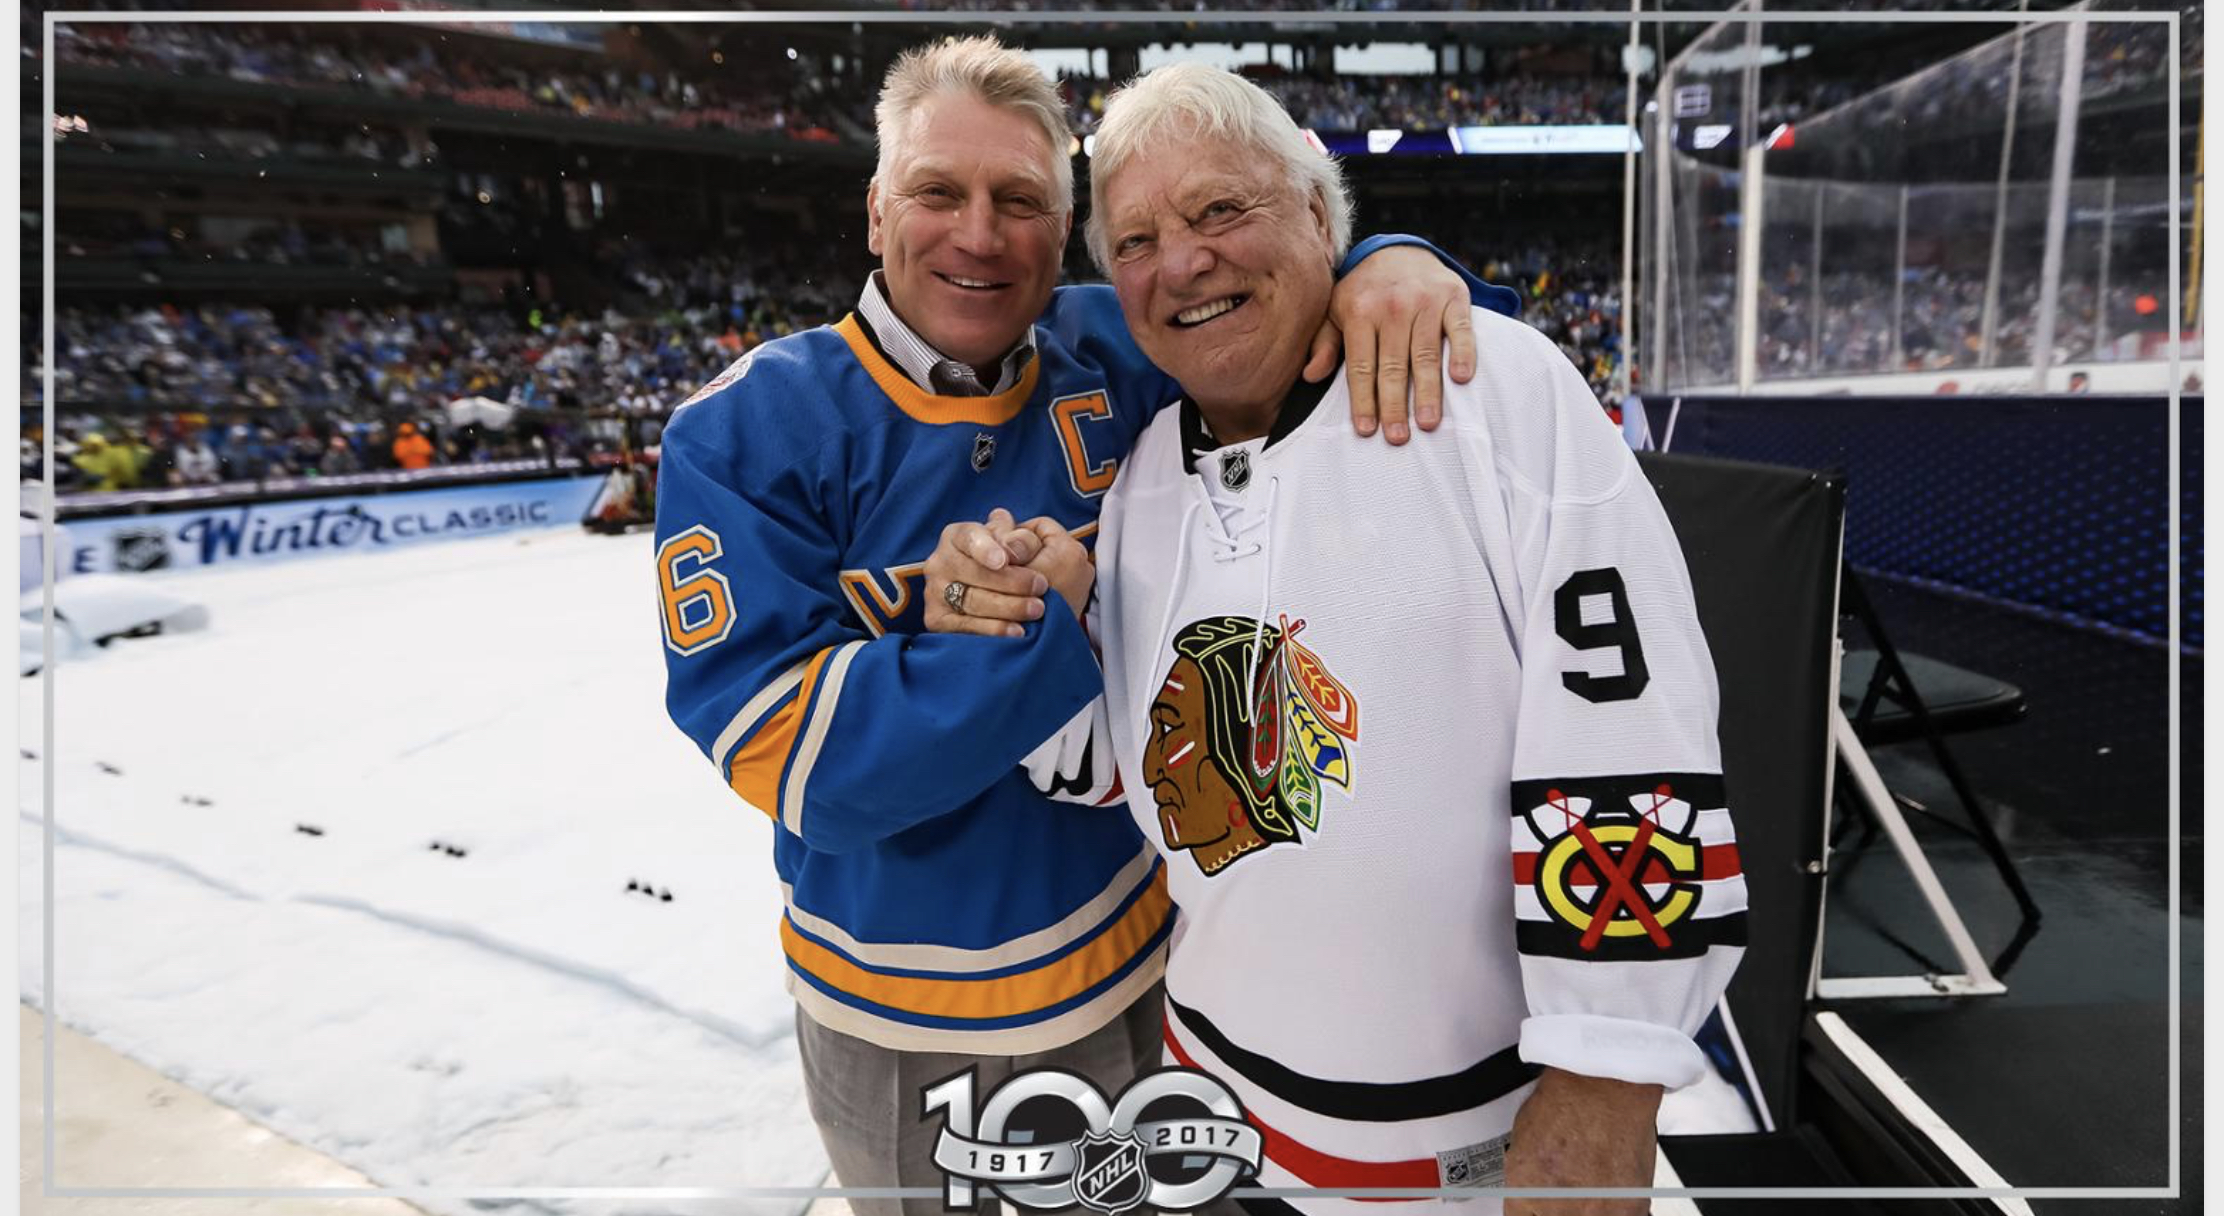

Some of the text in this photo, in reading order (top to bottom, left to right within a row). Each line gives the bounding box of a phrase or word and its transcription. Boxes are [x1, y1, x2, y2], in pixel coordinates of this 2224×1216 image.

[1049, 389, 1117, 498] C
[177, 497, 388, 564] Winter
[392, 500, 549, 537] CLASSIC
[655, 524, 738, 657] 6
[1555, 567, 1650, 703] 9
